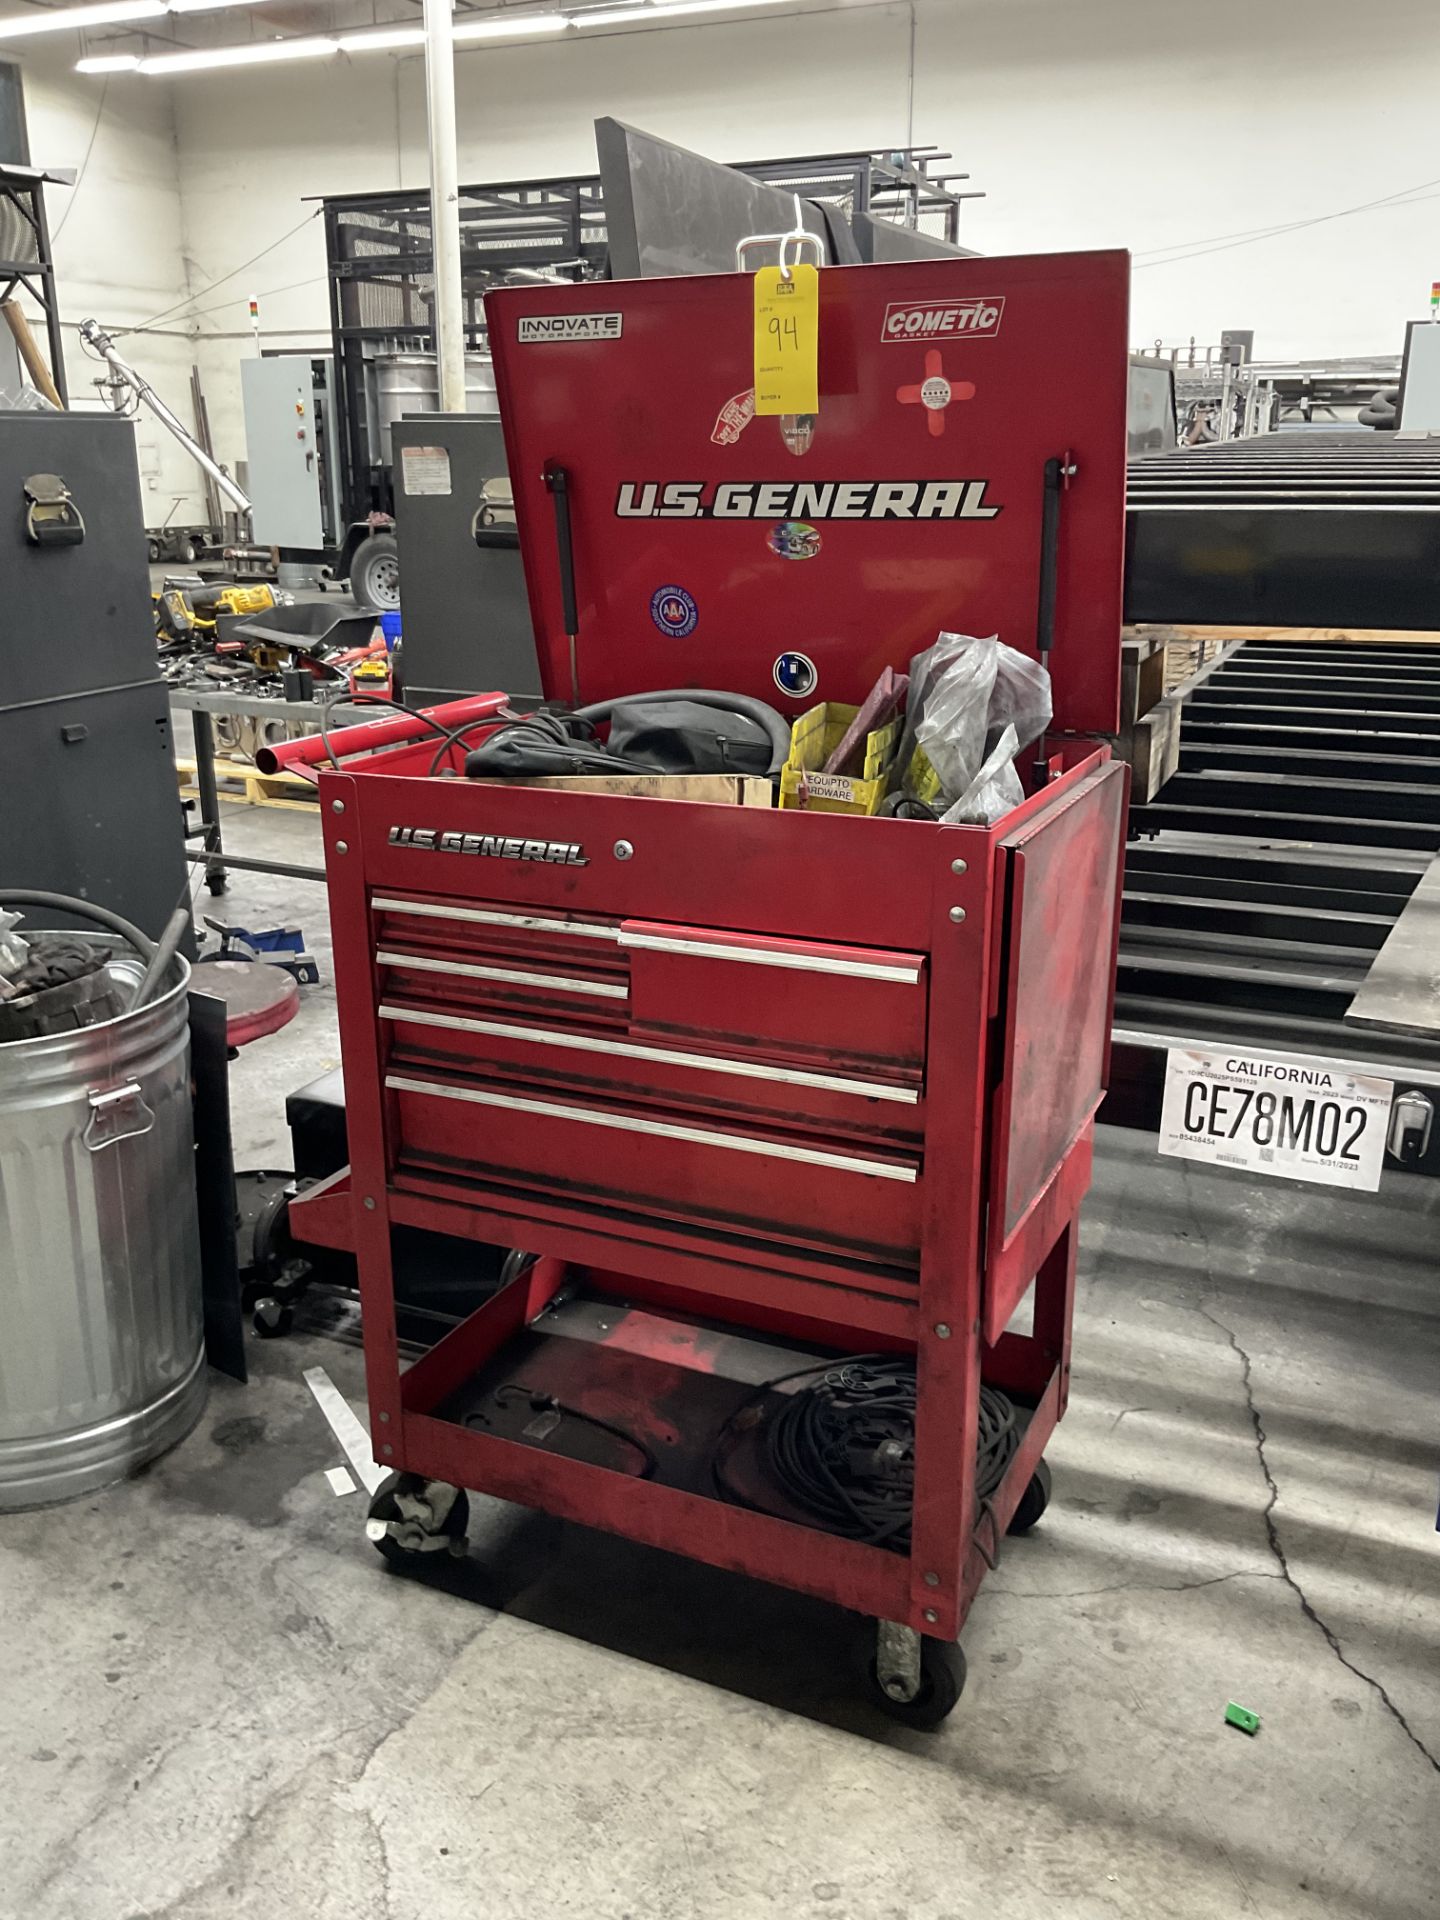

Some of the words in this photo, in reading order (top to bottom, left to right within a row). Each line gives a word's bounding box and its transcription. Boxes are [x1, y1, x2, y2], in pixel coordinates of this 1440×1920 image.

[522, 316, 619, 333] INNOVATE
[887, 301, 998, 333] COMETIC
[522, 330, 618, 339] MOTORSPORTS
[768, 316, 798, 352] 94
[720, 401, 739, 423] VANS
[729, 411, 746, 429] THE
[616, 483, 703, 517] U.S.
[712, 481, 999, 517] GENERAL
[663, 601, 685, 617] AAA
[803, 785, 852, 800] ARDWARE
[807, 775, 850, 789] EQUIPTO
[439, 831, 592, 866] GENERAL
[1226, 1059, 1333, 1088] CALIFORNIA
[1184, 1081, 1368, 1161] CE78M02
